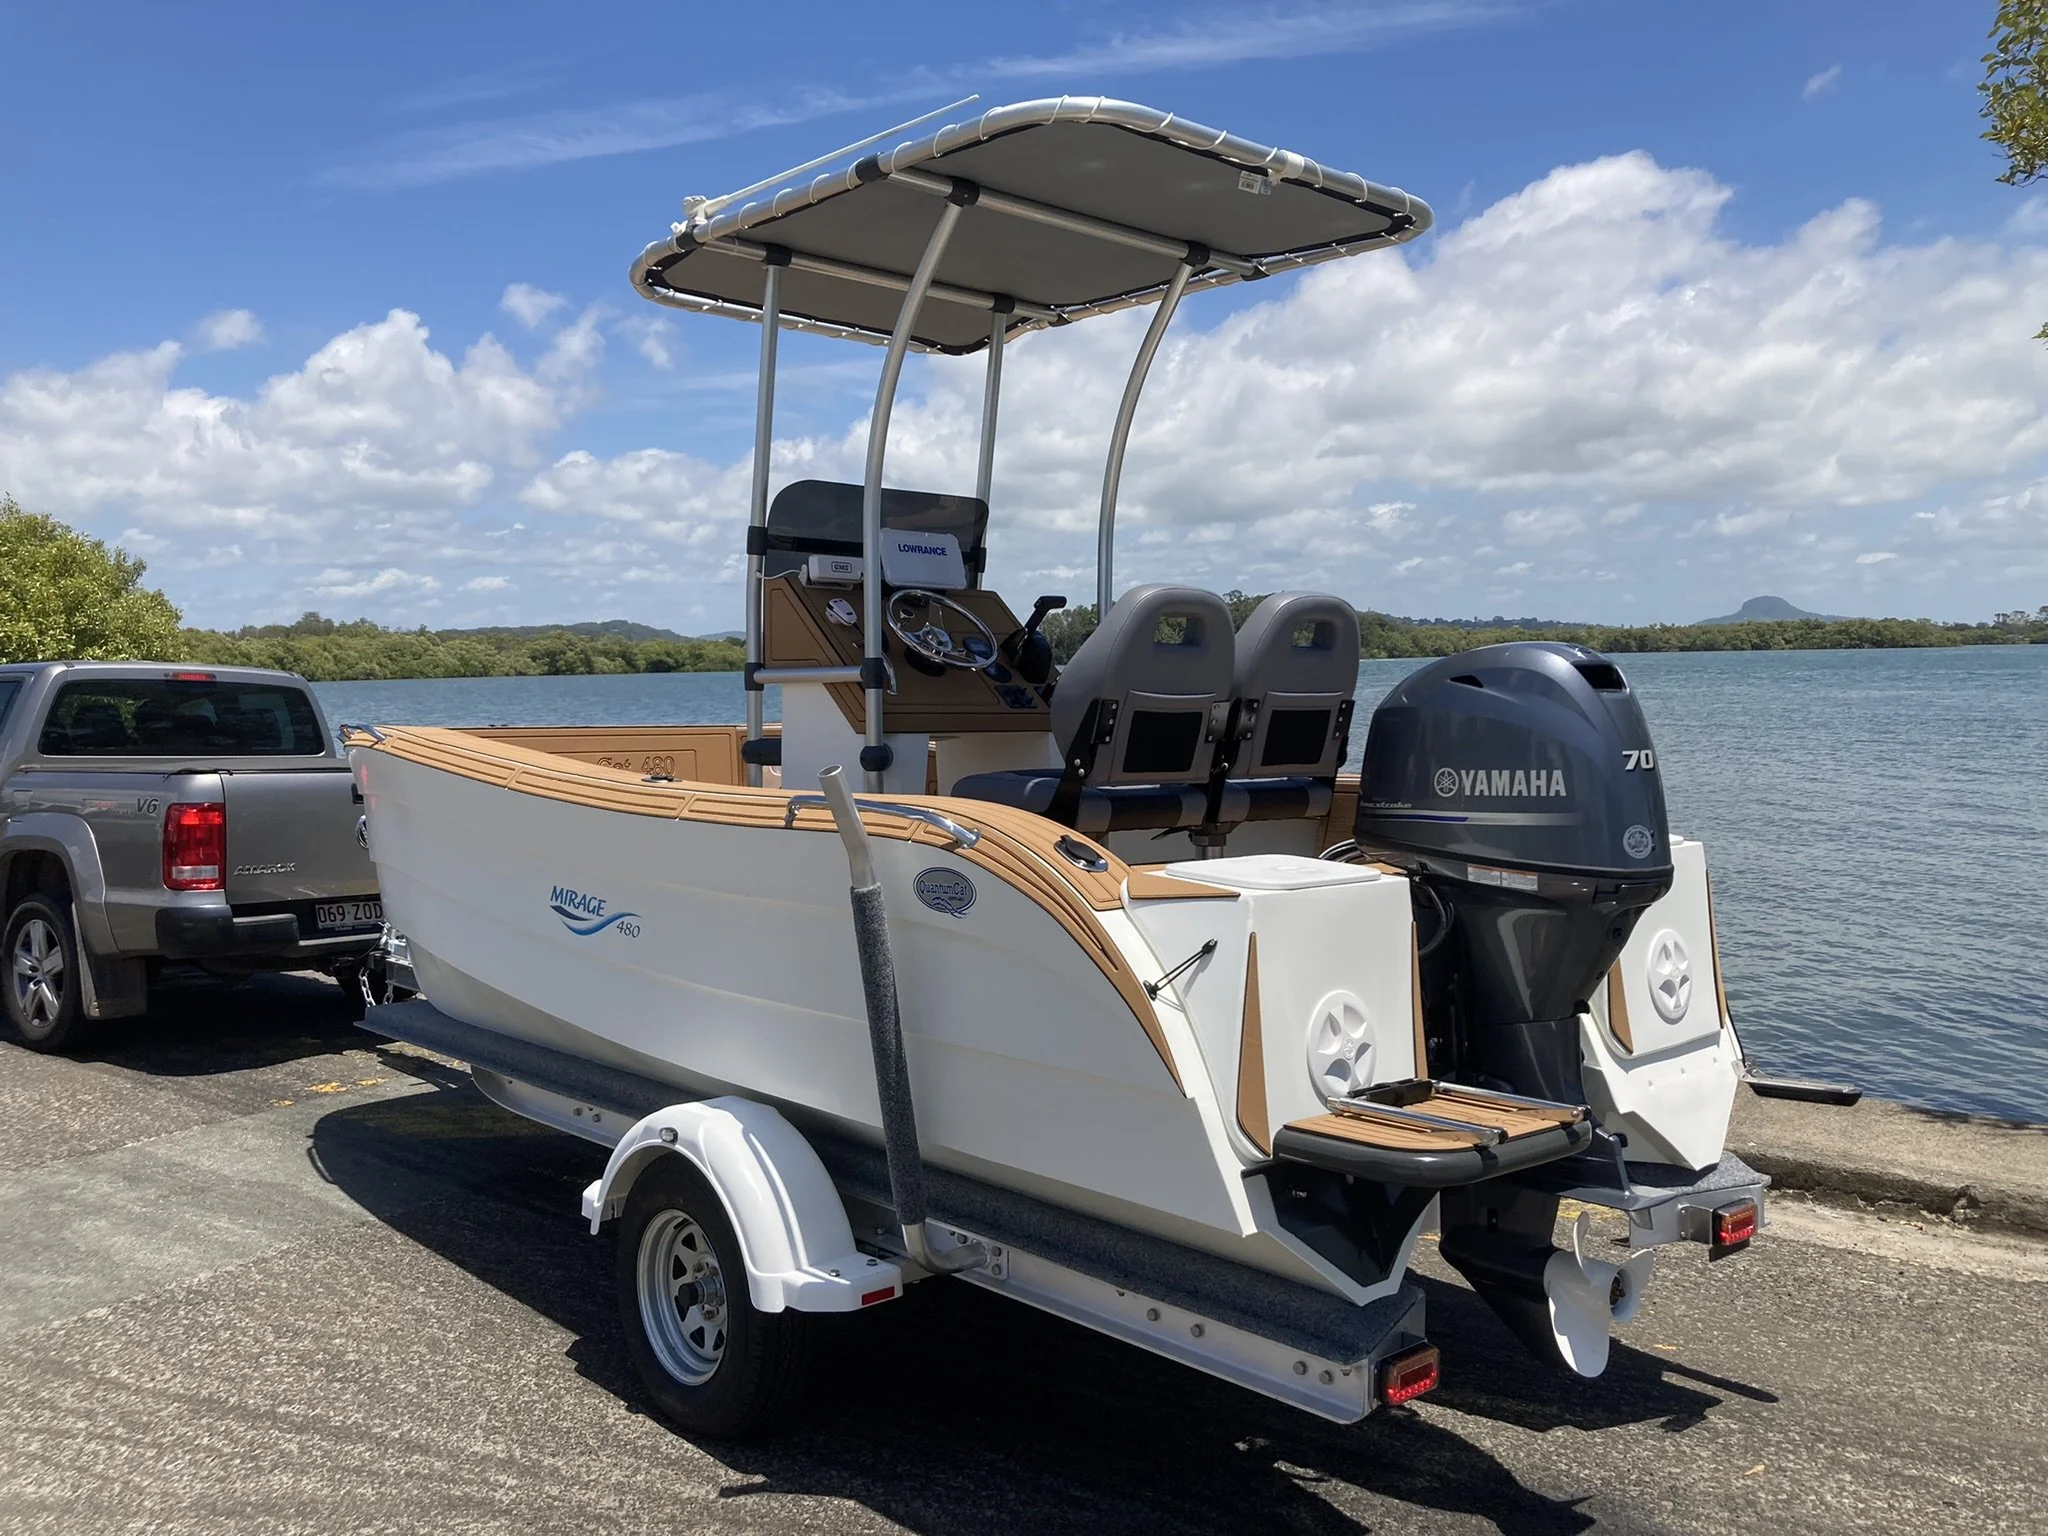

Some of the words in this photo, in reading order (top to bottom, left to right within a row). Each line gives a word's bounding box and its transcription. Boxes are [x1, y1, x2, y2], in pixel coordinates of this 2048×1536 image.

[897, 543, 948, 556] LOWRANCE
[641, 755, 676, 777] 480
[1622, 750, 1655, 771] 70
[1460, 769, 1567, 797] YAMAHA
[136, 798, 159, 814] V6
[550, 885, 607, 917] MIRAGE
[616, 920, 641, 938] 480
